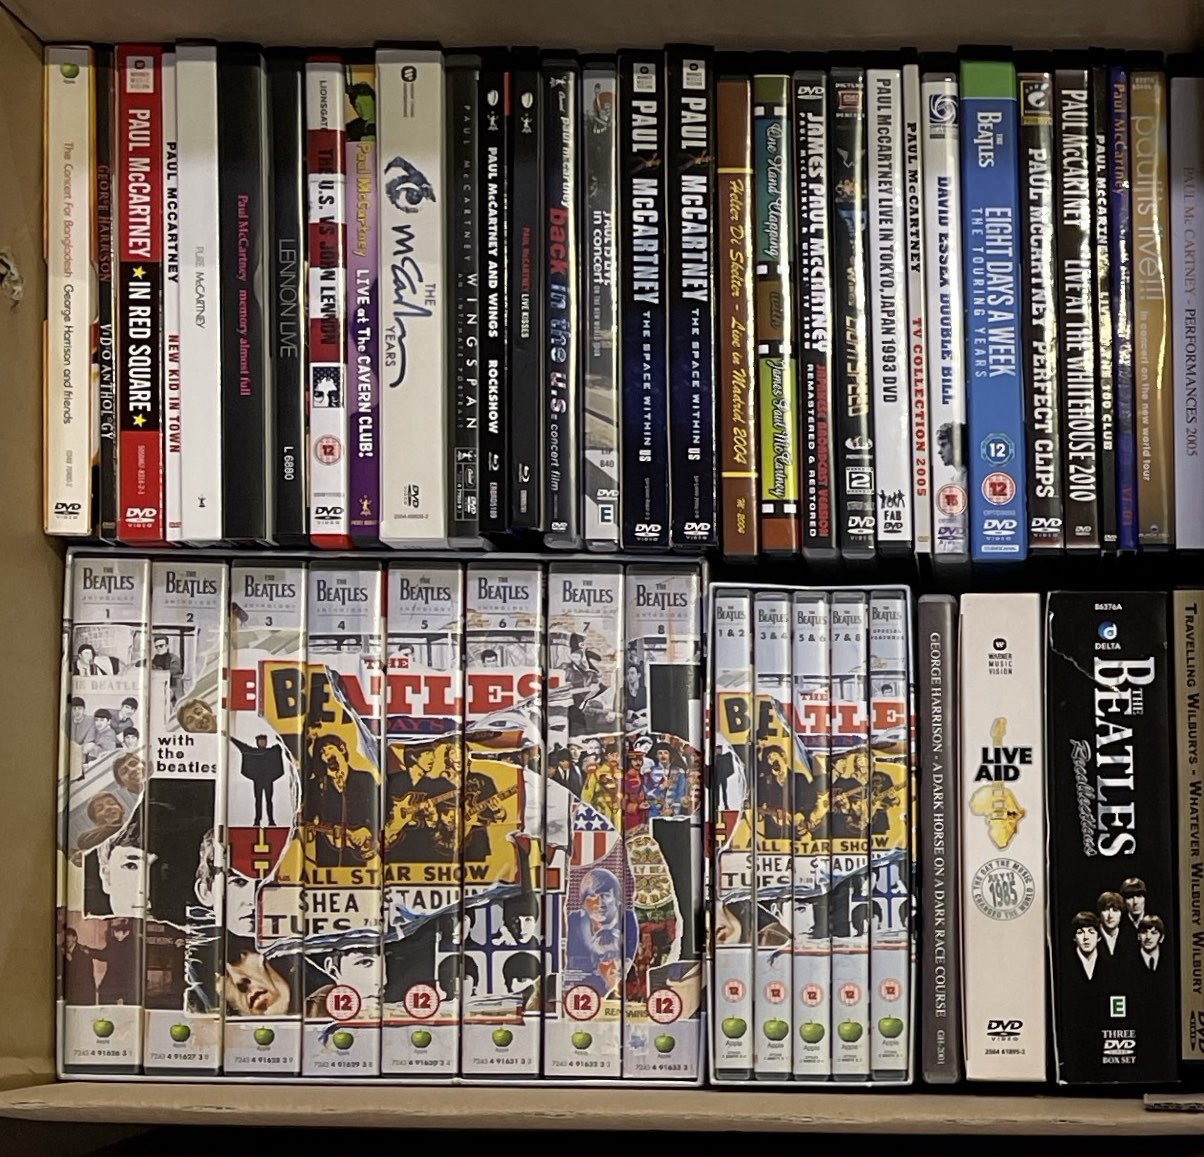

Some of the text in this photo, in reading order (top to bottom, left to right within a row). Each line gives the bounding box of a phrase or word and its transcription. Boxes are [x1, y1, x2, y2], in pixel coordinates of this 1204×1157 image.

[128, 110, 149, 152] PAUL
[632, 101, 658, 152] PAUL
[129, 282, 150, 300] IN
[985, 208, 1016, 377] EIGHT DAYS A WEEK
[129, 306, 151, 339] RED
[642, 312, 650, 338] THE
[385, 326, 396, 368] YEARS
[488, 292, 499, 434] WINGS ROCKSHOW
[642, 344, 651, 390] SPACE
[129, 345, 151, 412] SQUARE
[169, 335, 180, 453] NEW KID IN TOWN
[1185, 309, 1198, 456] PERFORMANCES 2005
[357, 356, 373, 458] CAVERN CLUB!
[643, 396, 651, 447] WITHIN
[83, 568, 134, 592] BEATLES
[1131, 689, 1143, 715] THE
[1185, 603, 1201, 766] TRAVELLING WILBURYS
[157, 734, 194, 747] with
[157, 748, 185, 760] the
[982, 748, 1032, 764] LIVE
[1093, 657, 1155, 856] BEATLES
[157, 761, 216, 773] beatles
[975, 765, 1020, 781] AID
[1102, 1030, 1136, 1038] THREE
